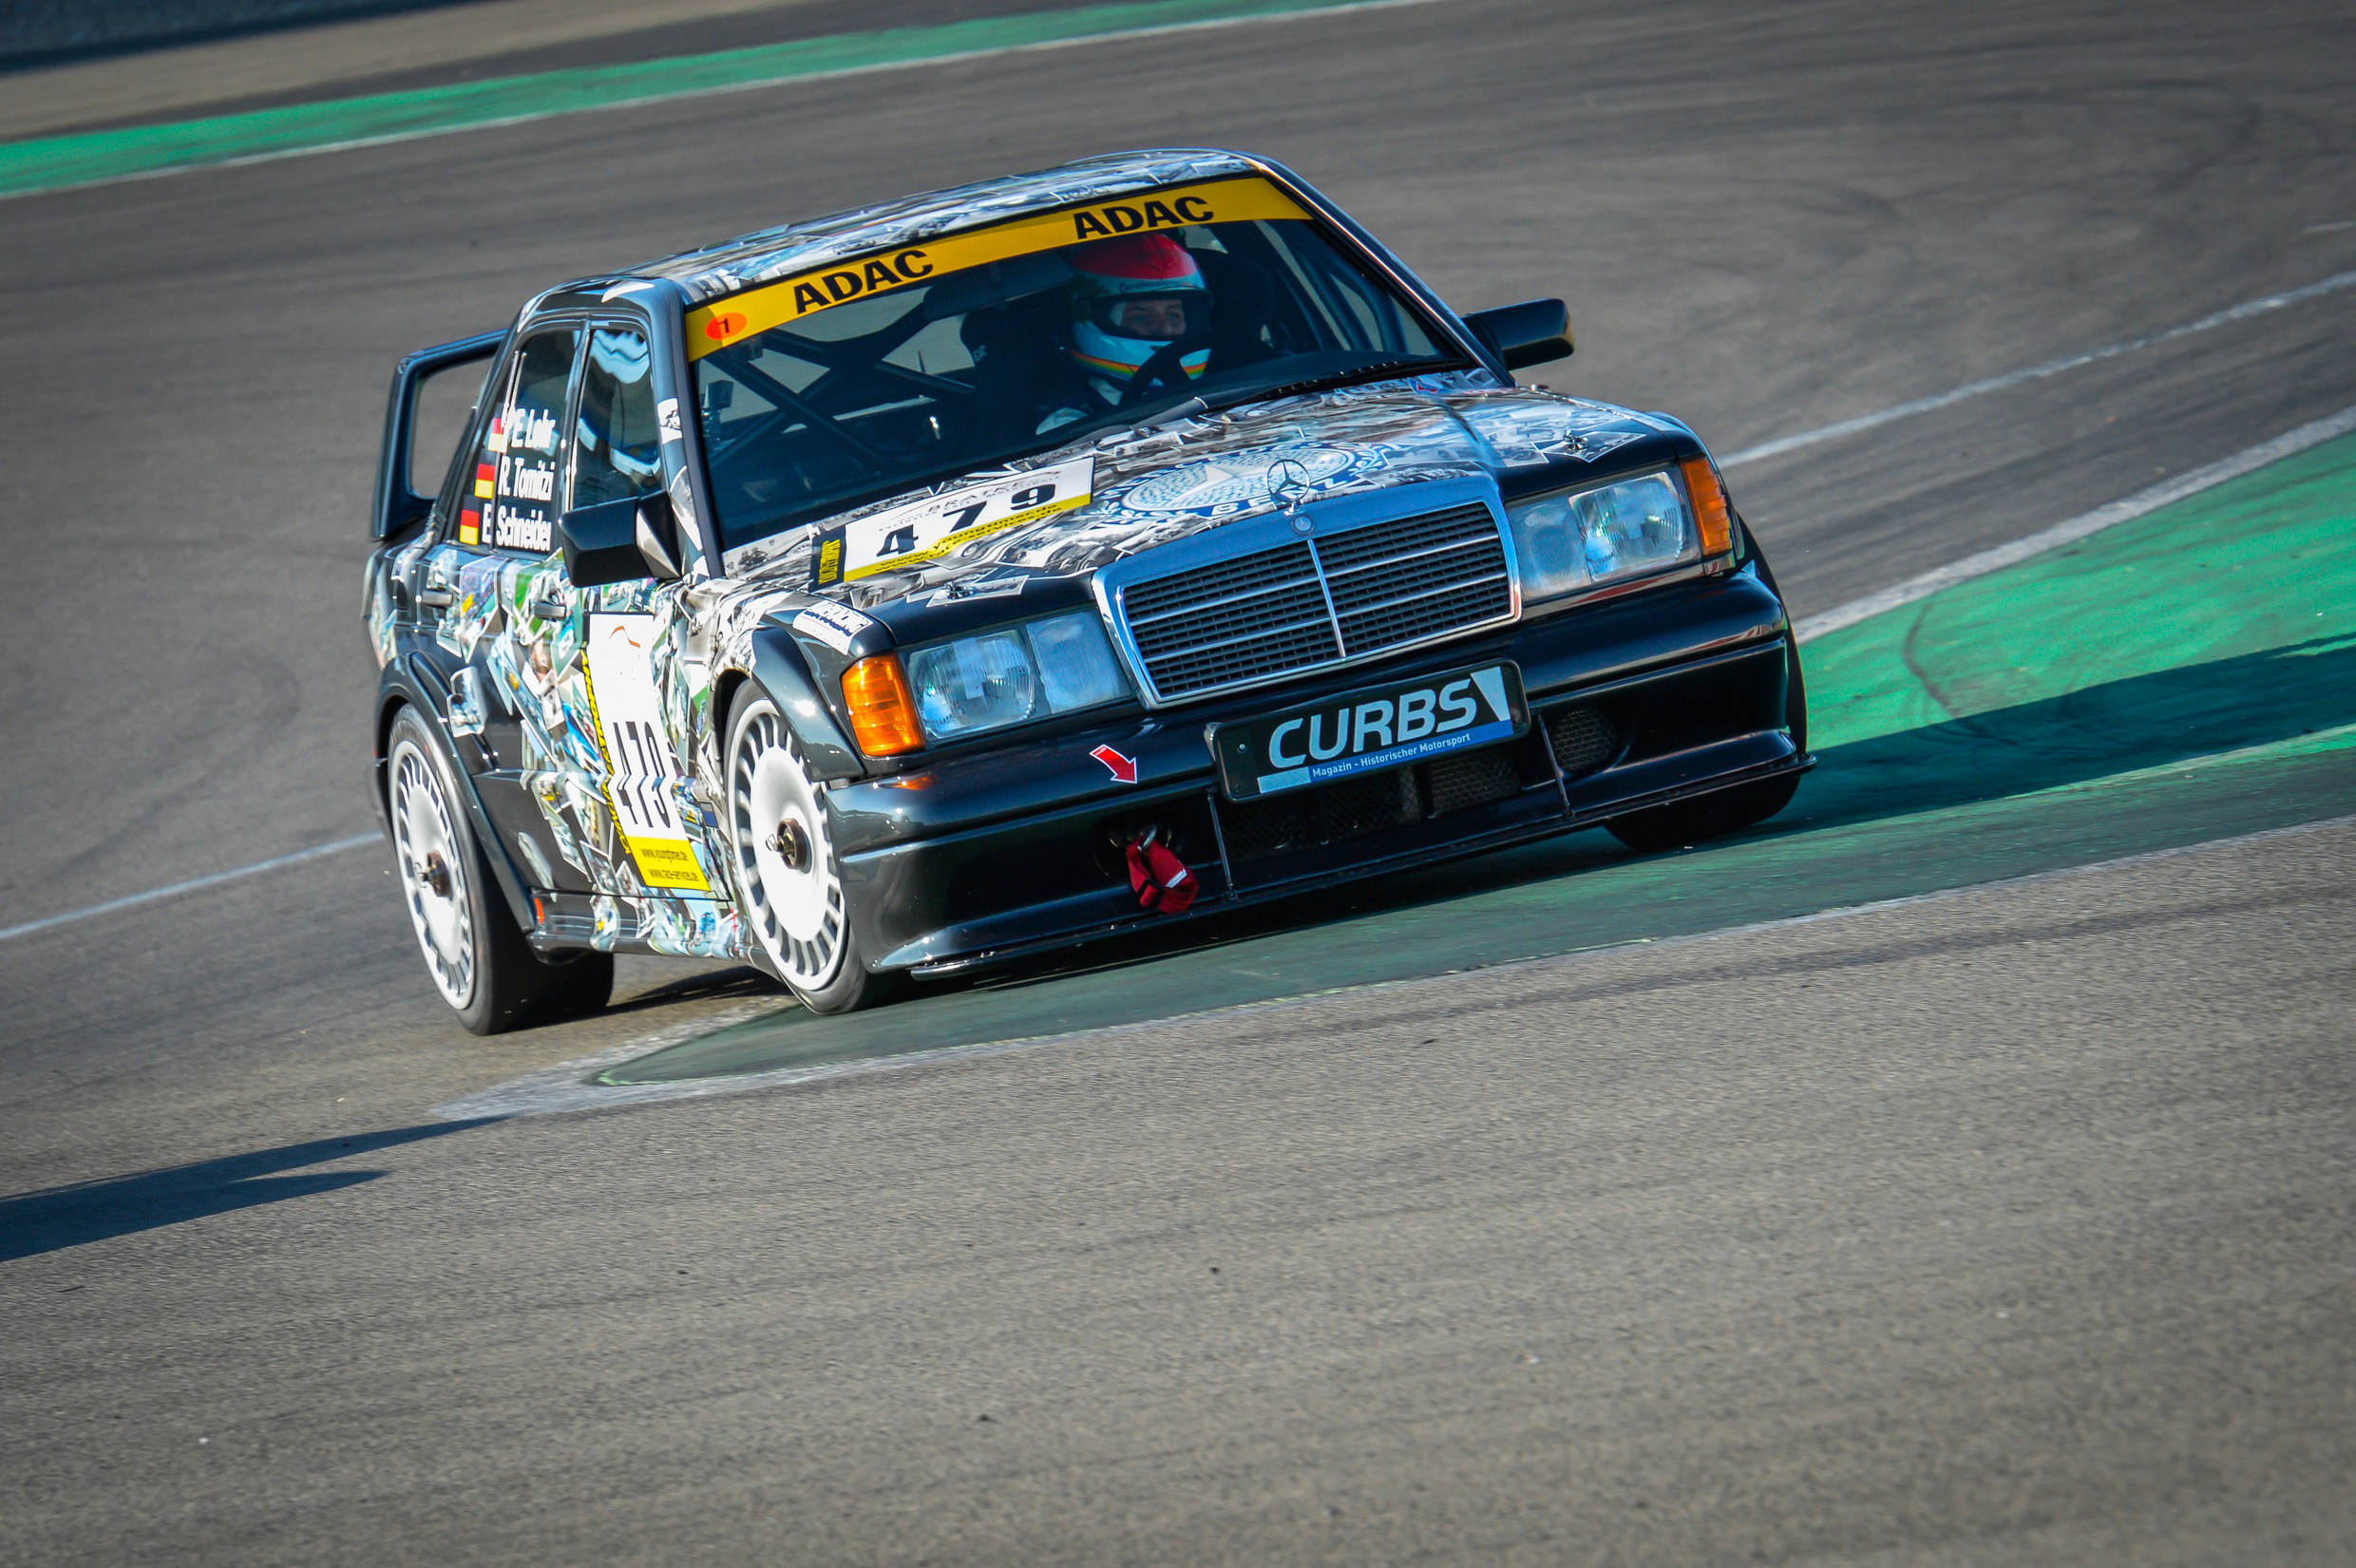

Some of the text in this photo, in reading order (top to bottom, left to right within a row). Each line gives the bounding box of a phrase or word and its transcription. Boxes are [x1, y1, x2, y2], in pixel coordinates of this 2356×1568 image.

[1074, 196, 1214, 240] ADAC
[792, 250, 934, 315] ADAC
[496, 504, 552, 552] Schneider
[876, 483, 1056, 557] 479
[1268, 678, 1478, 769] CURBS
[1312, 761, 1353, 779] Magazin
[1360, 745, 1418, 767] Historischer
[1419, 731, 1472, 753] Motorsport
